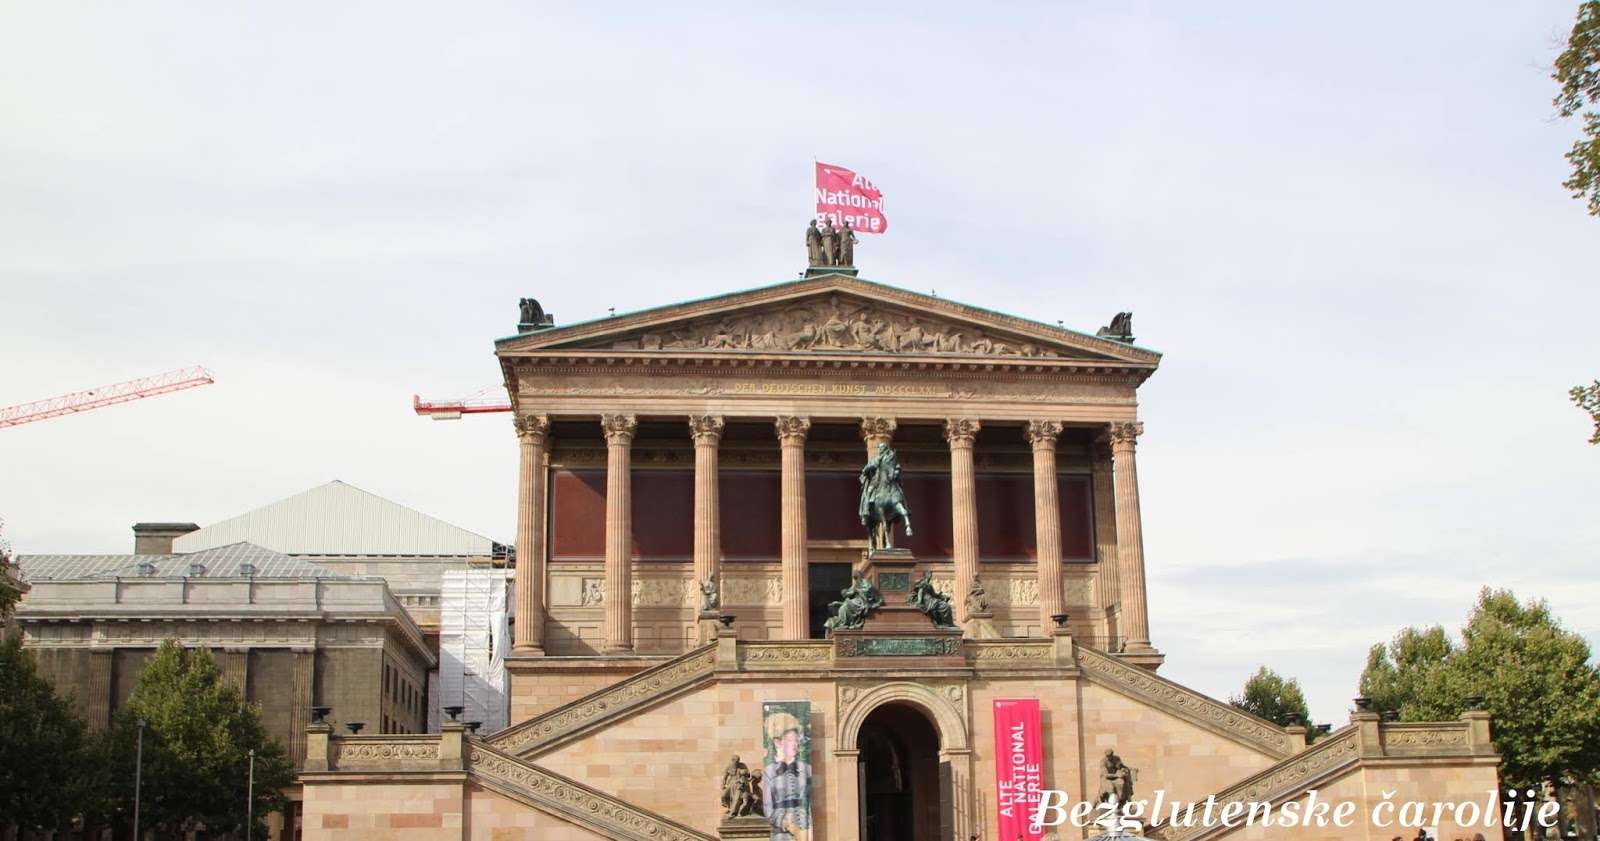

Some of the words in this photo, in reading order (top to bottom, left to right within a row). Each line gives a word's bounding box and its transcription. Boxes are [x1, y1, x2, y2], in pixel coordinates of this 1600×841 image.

[816, 187, 885, 214] National
[816, 209, 881, 230] galerie
[734, 382, 756, 393] DER
[762, 383, 826, 394] DEUTSCHEN
[832, 384, 868, 394] KUNST
[875, 385, 936, 395] MDCCCLXXI
[1012, 721, 1026, 803] NATIONAL
[1000, 780, 1013, 818] ALTE
